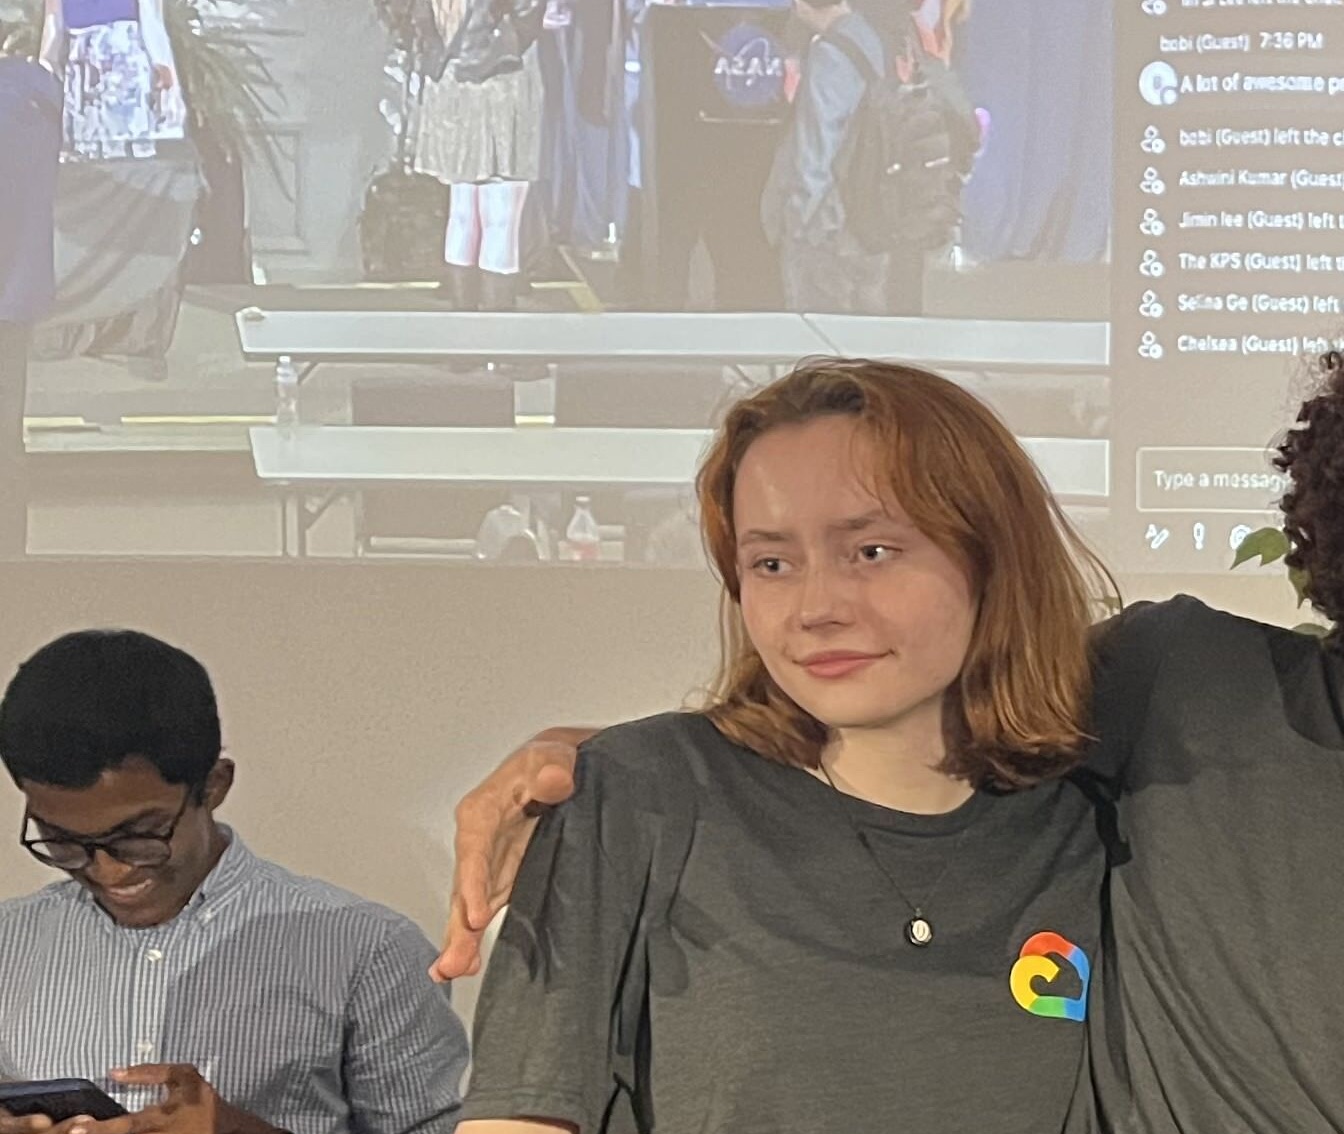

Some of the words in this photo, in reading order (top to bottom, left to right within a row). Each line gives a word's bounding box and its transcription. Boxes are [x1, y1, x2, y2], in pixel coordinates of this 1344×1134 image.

[1297, 32, 1324, 49] PM
[1180, 75, 1193, 93] A
[1196, 75, 1218, 92] lot
[1222, 73, 1240, 91] of
[1243, 76, 1325, 92] awesome
[1215, 128, 1270, 148] (Guest)
[1273, 128, 1299, 145] left
[1303, 128, 1329, 146] the
[1238, 170, 1287, 186] Kumar
[1247, 211, 1303, 231] (Guest)
[1308, 212, 1335, 229] left
[1178, 253, 1206, 270] The
[1244, 252, 1302, 273] (Guest)
[1306, 254, 1332, 271] left
[1226, 294, 1248, 311] Ge
[1252, 294, 1310, 314] (Guest)
[1313, 296, 1340, 313] left
[1177, 335, 1237, 352] Chelsea
[1242, 335, 1298, 355] (Guest)
[1154, 470, 1195, 491] Type
[1198, 473, 1209, 488] a
